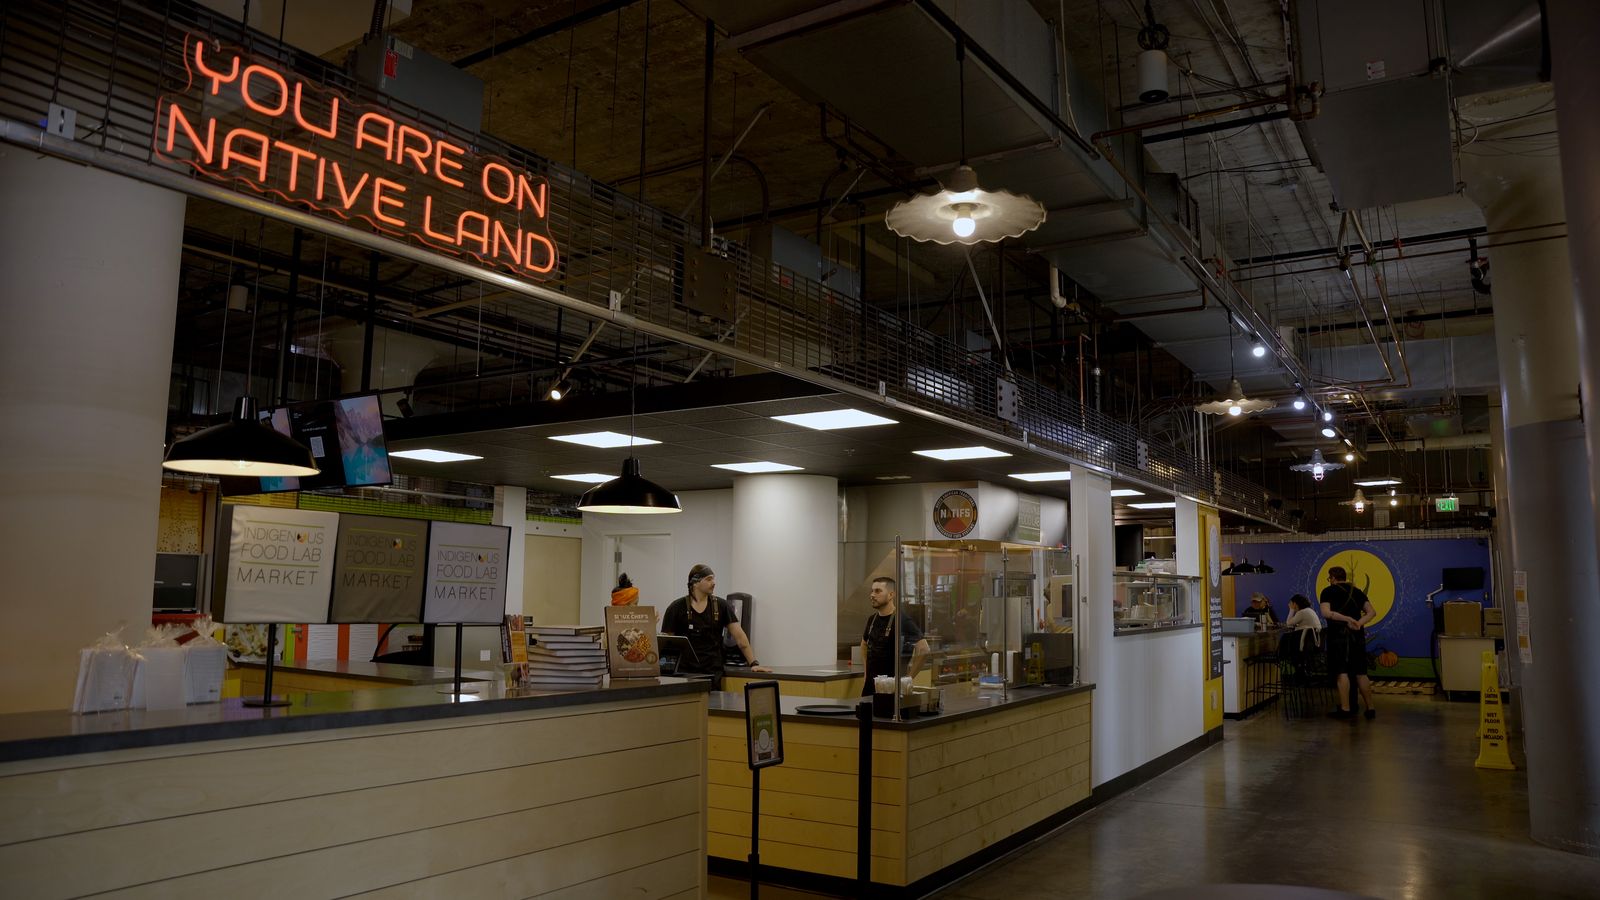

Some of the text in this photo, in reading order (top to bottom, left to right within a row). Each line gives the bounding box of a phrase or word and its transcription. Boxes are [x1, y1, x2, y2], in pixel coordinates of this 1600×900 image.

[196, 41, 546, 219] YOU ARE ON
[166, 103, 555, 273] NATIVE LAND
[1440, 499, 1455, 511] EXIT
[241, 543, 322, 562] FOOD LAB
[345, 550, 416, 568] FOOD LAB
[237, 567, 318, 586] MARKET
[343, 572, 412, 590] MARKET
[436, 564, 498, 580] FOOD LAB
[434, 585, 497, 601] MARKET
